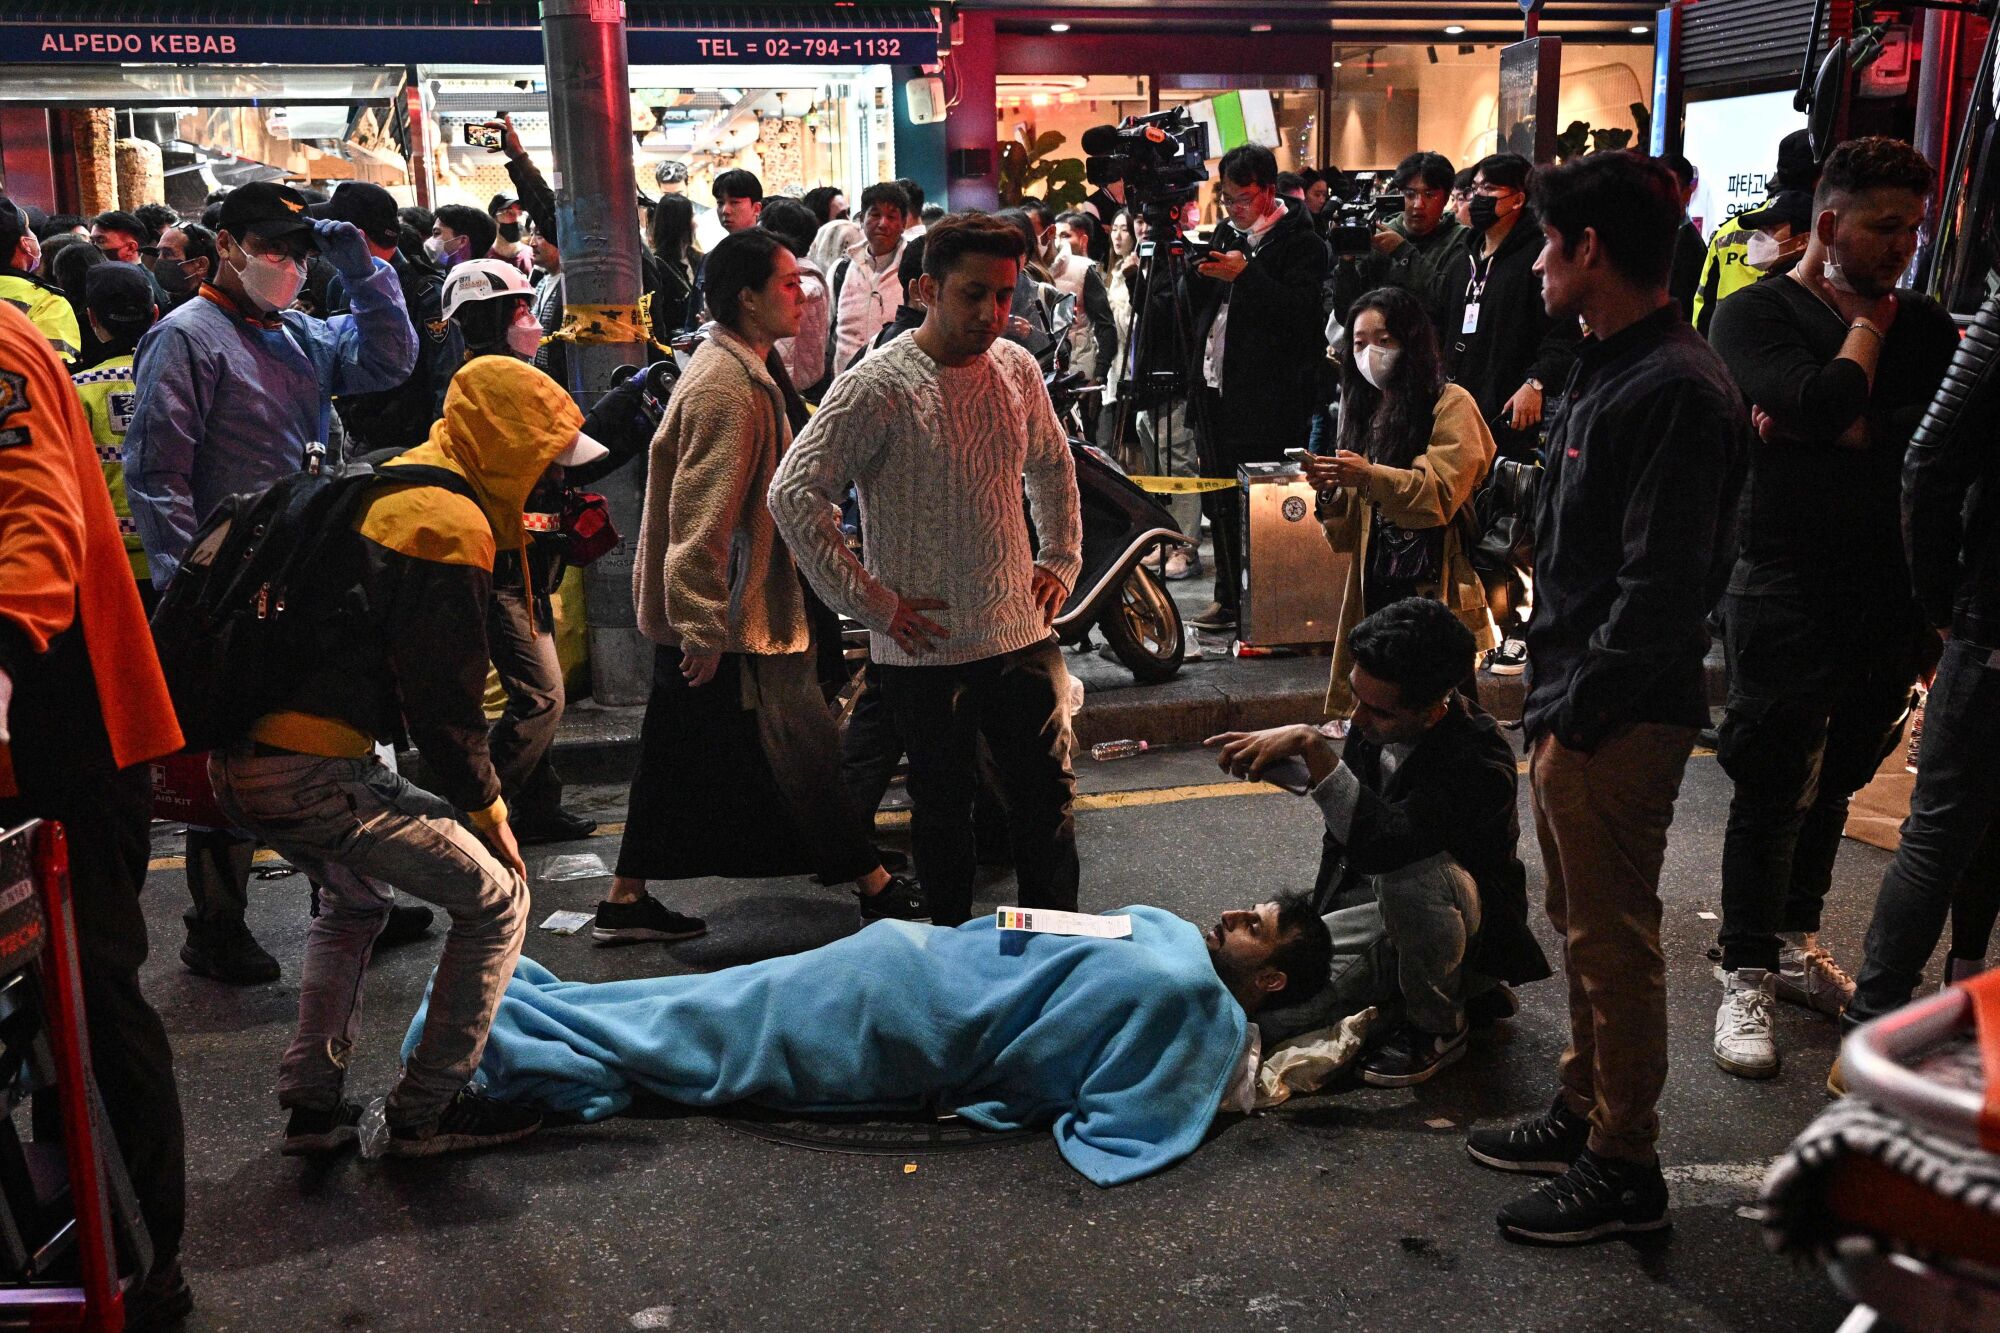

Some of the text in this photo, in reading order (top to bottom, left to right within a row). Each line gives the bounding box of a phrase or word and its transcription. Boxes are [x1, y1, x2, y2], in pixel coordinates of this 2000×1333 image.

[41, 34, 237, 54] ALPEDO KEBAB
[697, 39, 738, 57] TEL
[765, 39, 901, 57] 02-794-1132
